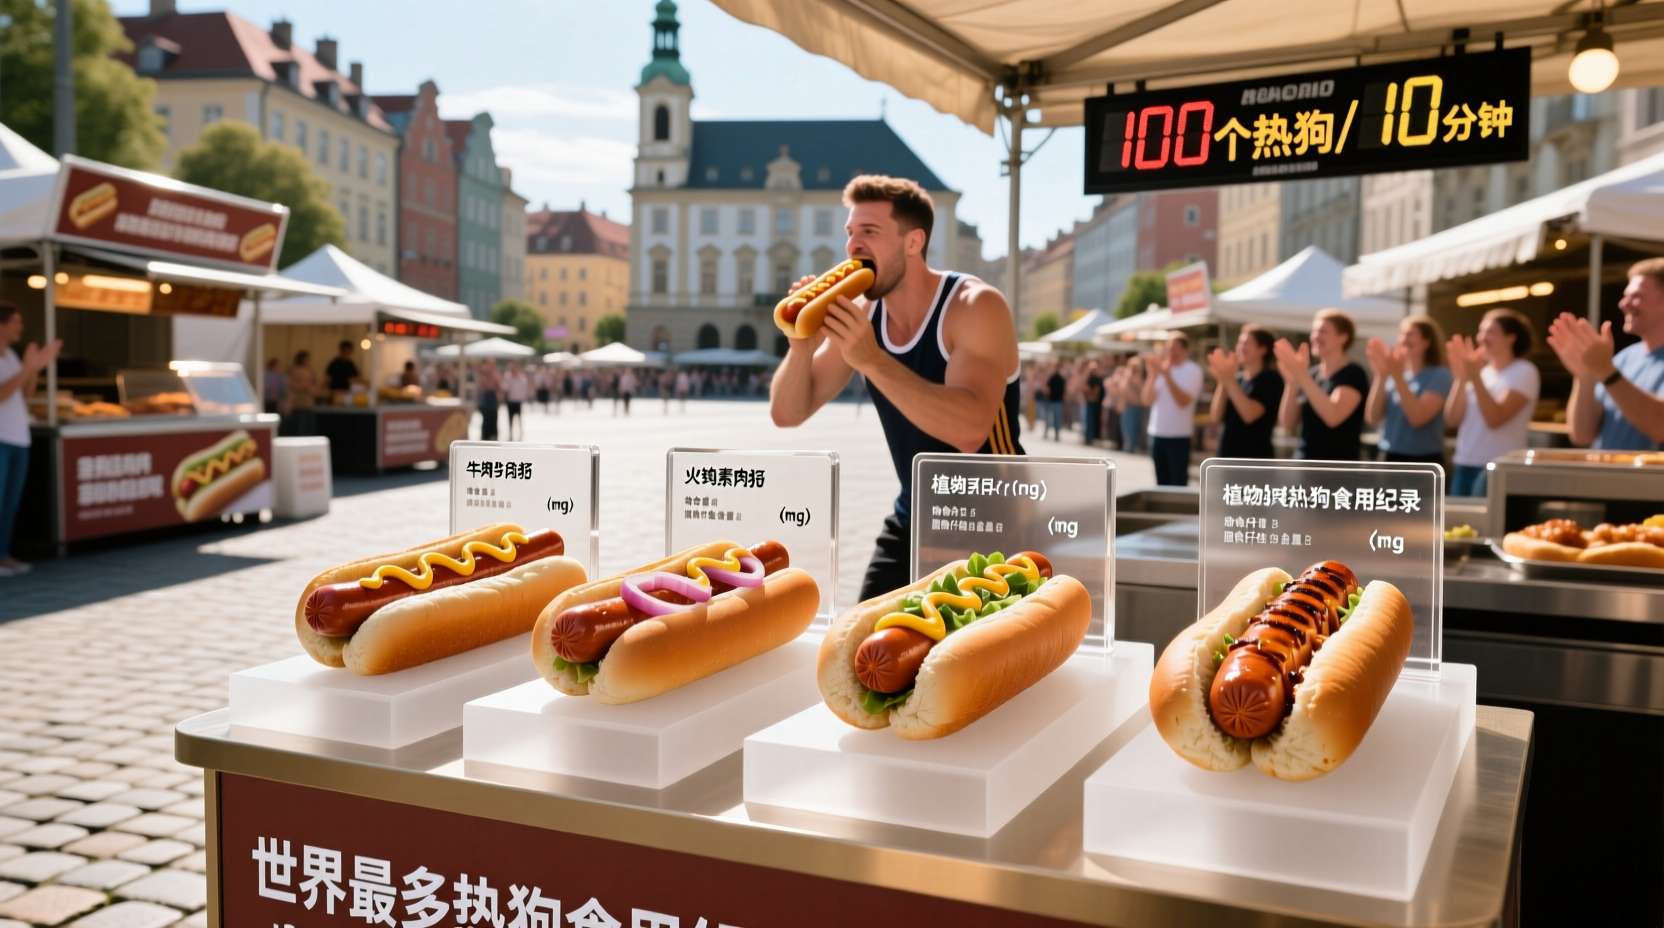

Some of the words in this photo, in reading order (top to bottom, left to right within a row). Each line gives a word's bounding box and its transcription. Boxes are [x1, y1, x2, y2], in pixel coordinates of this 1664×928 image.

[547, 496, 574, 515] (mg)
[779, 506, 811, 527] (mg)
[1369, 529, 1404, 554] (mg
